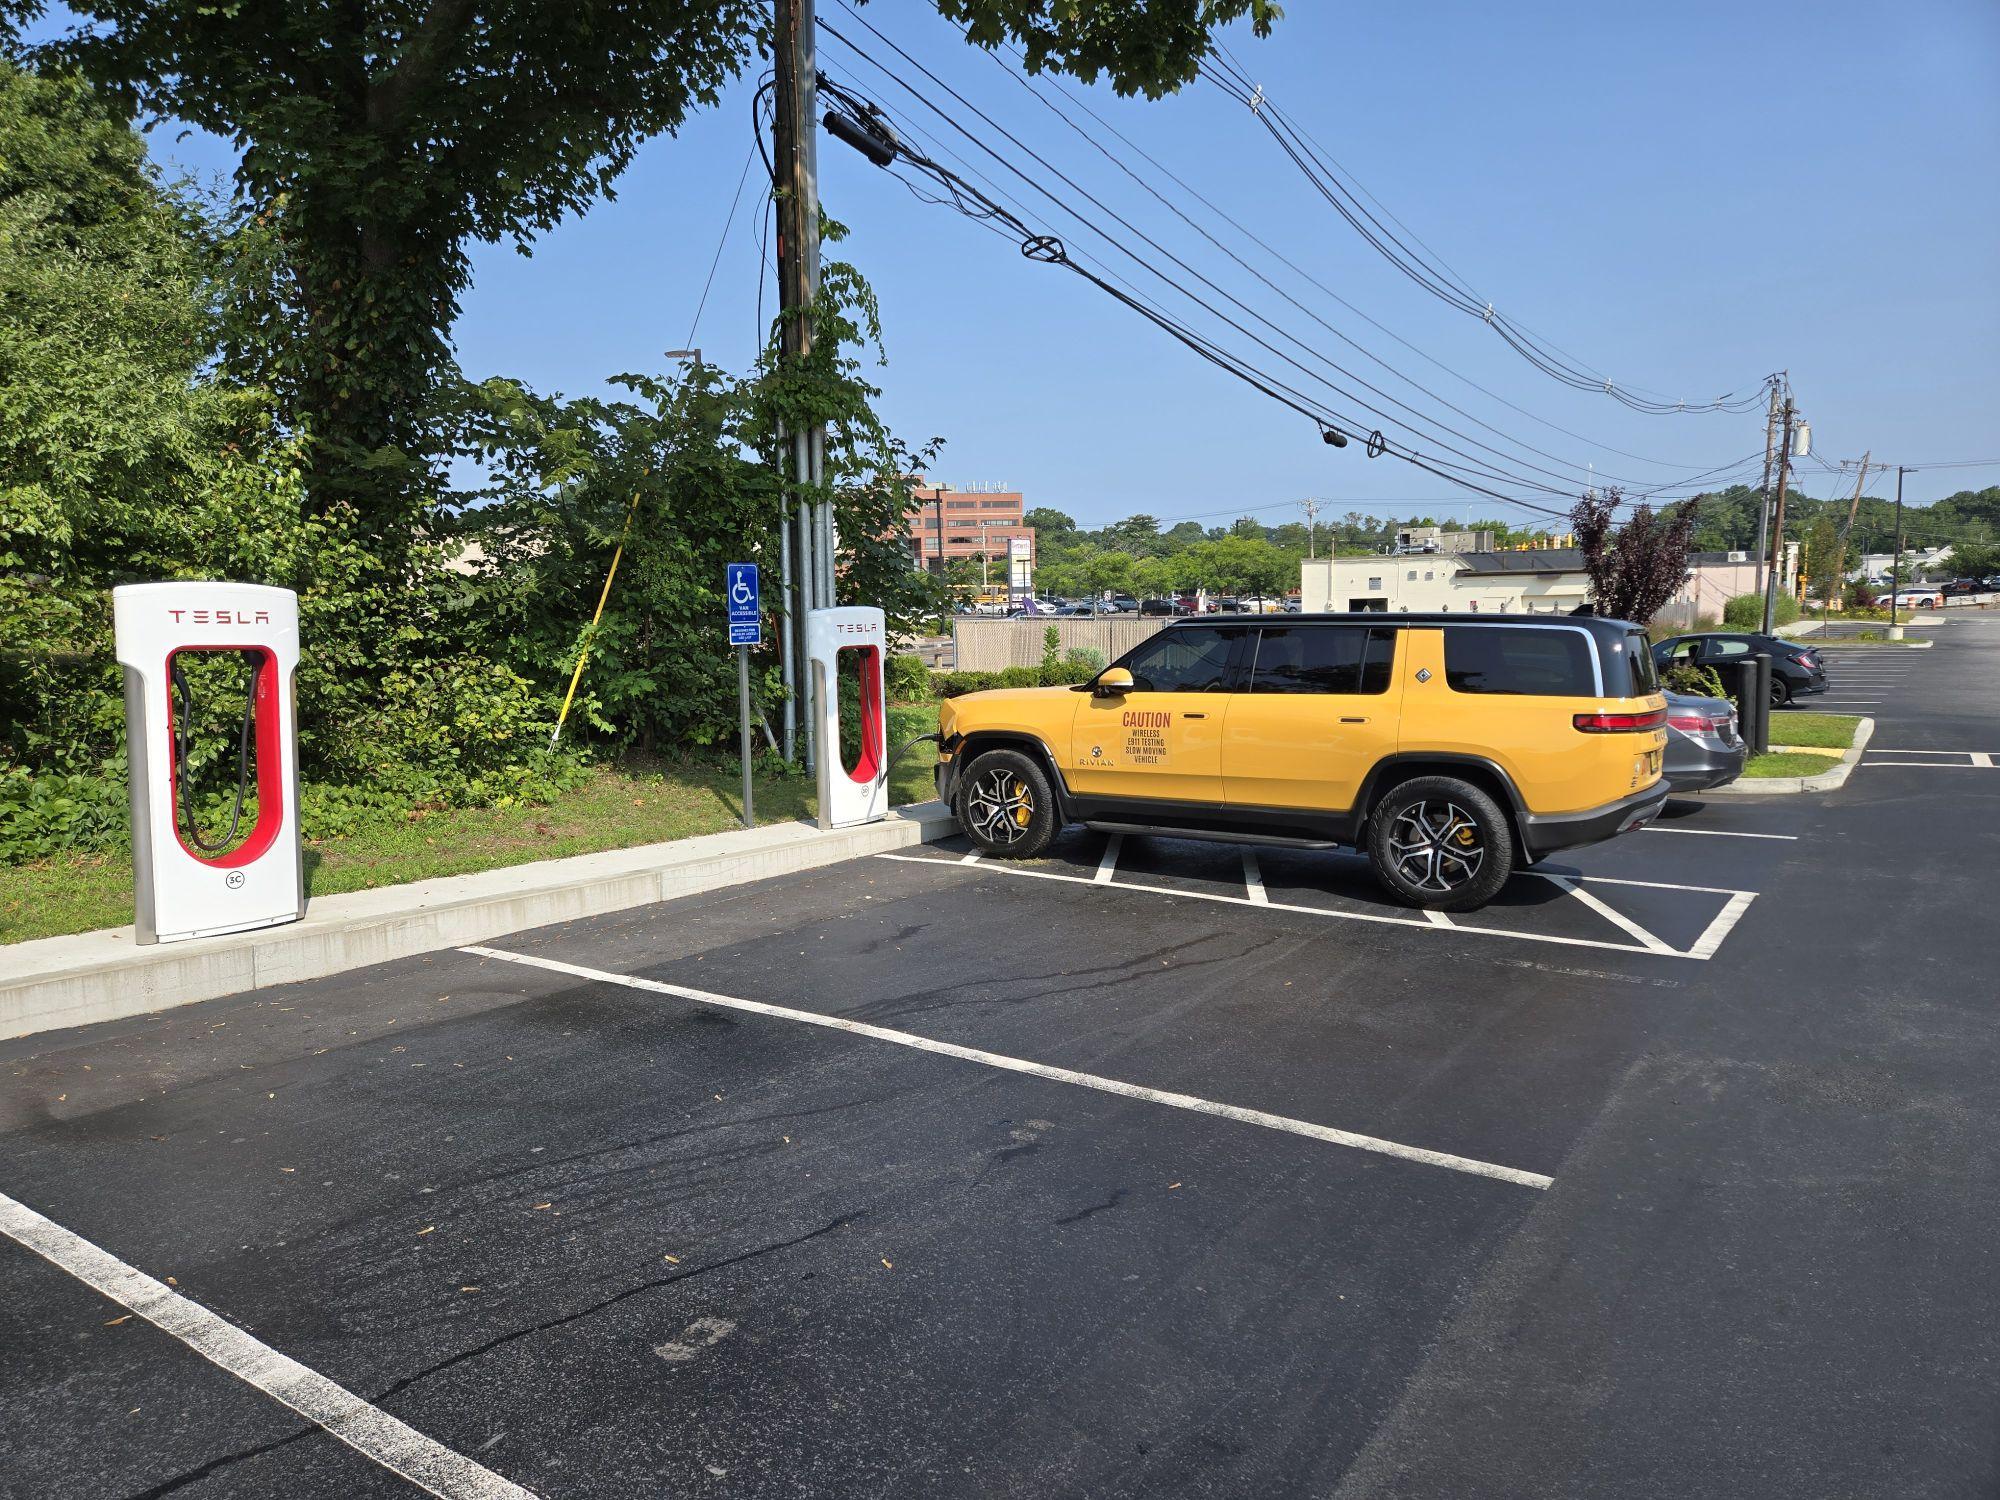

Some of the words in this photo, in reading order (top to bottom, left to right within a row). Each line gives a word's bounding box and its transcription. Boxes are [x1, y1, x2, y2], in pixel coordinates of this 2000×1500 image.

[168, 610, 269, 624] TESLA
[836, 623, 877, 633] TESLA
[1122, 711, 1171, 728] CAUTION
[1132, 729, 1160, 738] WIRELESS
[1127, 737, 1140, 746] E911
[1141, 738, 1165, 747] TESTING
[1125, 746, 1141, 755] SLOW
[1142, 747, 1167, 756] MOVING
[1079, 758, 1114, 767] RIVIAN
[1134, 755, 1158, 764] VEHICLE
[229, 875, 242, 884] 3C
